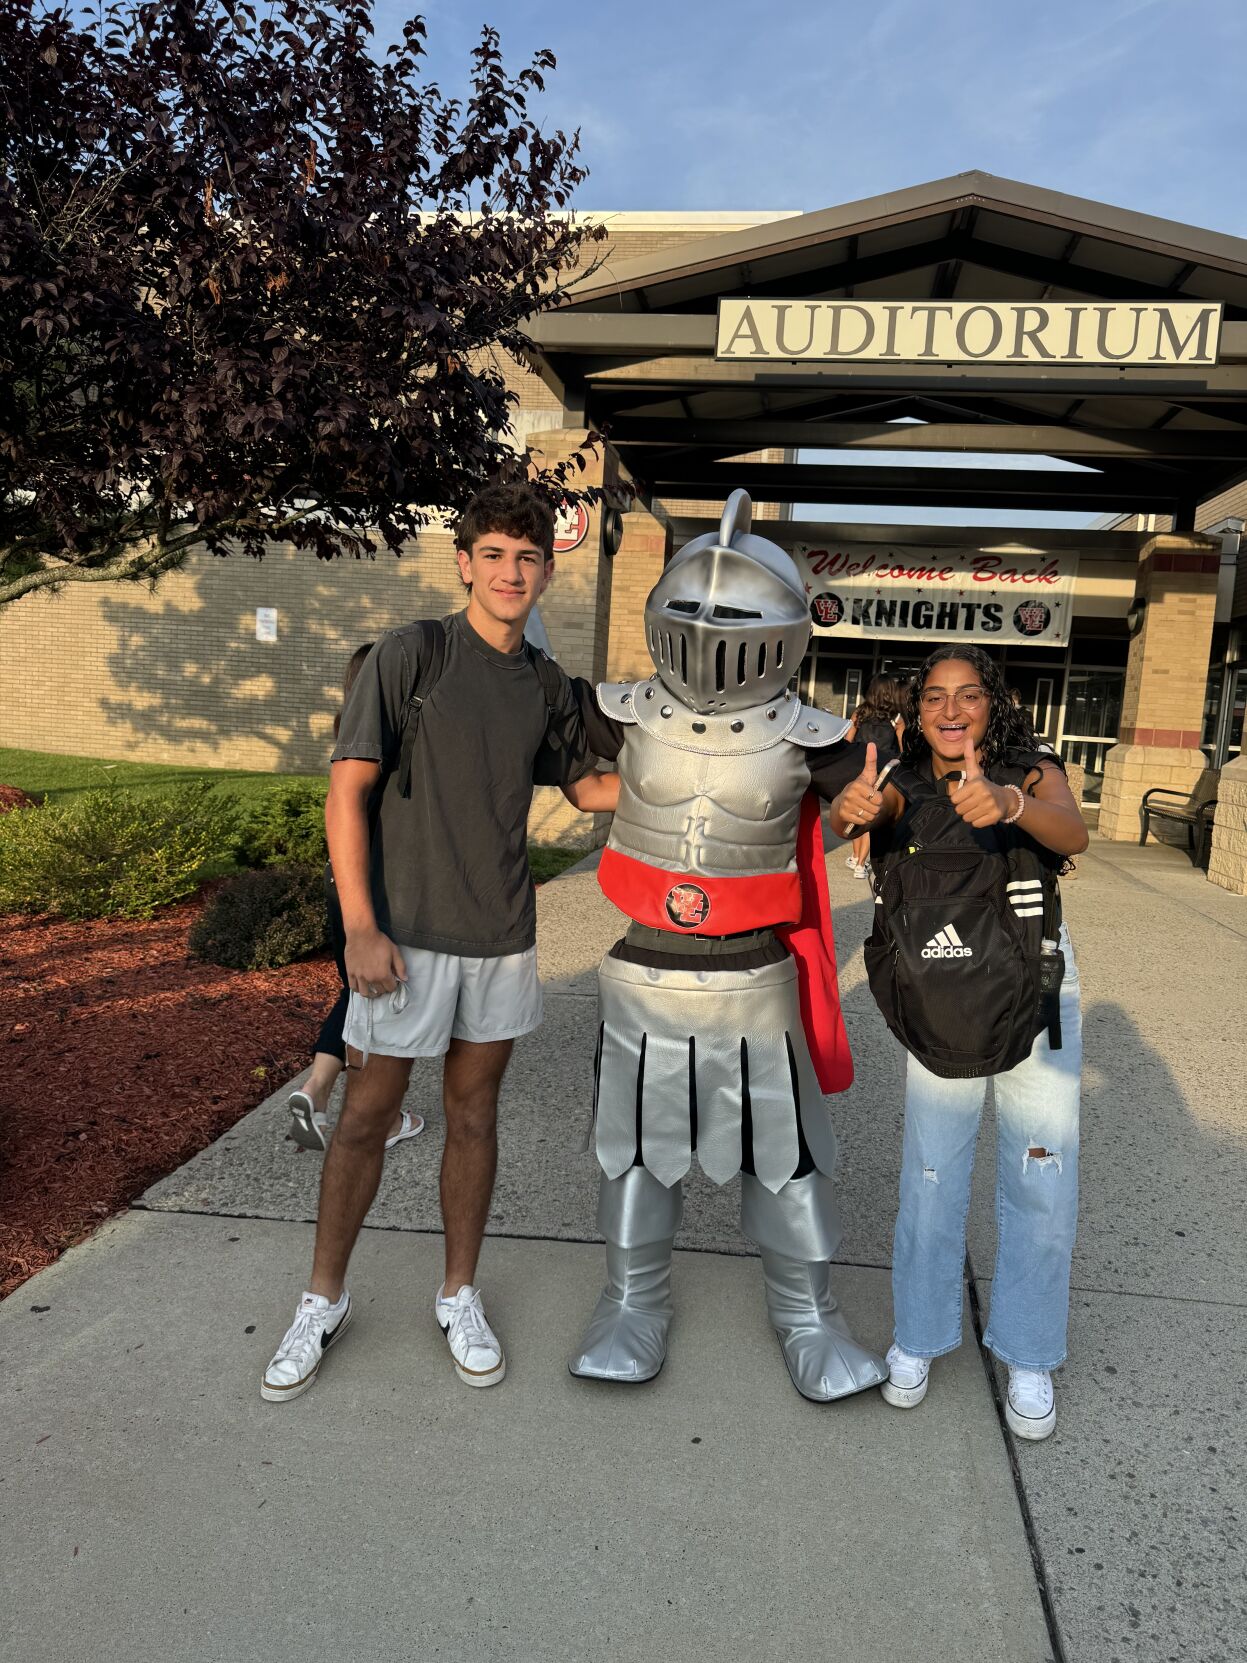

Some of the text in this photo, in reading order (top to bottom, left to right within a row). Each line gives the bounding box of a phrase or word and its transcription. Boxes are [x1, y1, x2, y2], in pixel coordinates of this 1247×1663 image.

[721, 305, 1217, 360] AUDITORIUM
[807, 550, 1062, 585] Welcome Back
[851, 598, 1003, 632] KNIGHTS
[921, 946, 973, 958] adidas
